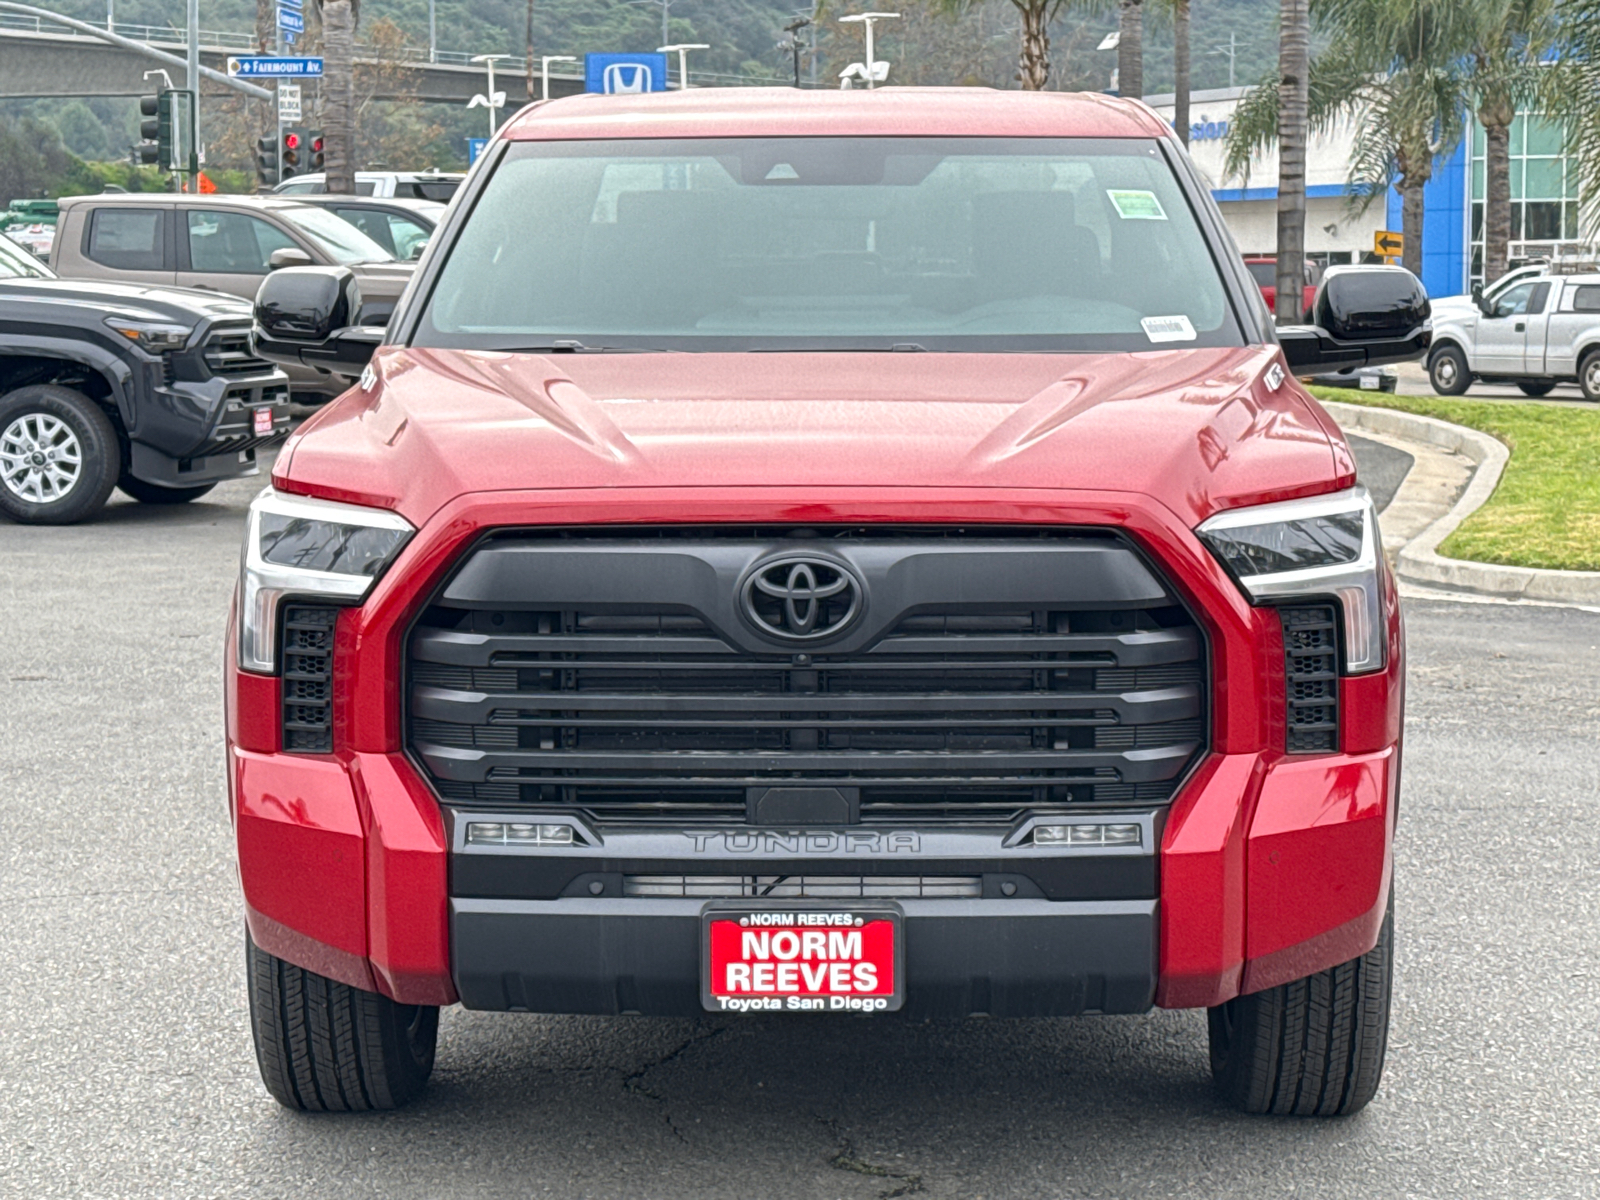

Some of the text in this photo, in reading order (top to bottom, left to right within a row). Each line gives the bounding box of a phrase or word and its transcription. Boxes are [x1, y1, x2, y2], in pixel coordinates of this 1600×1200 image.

[682, 830, 922, 853] TUNDRA
[750, 913, 853, 926] NORM REEVES
[741, 930, 862, 961] NORM
[726, 962, 879, 992] REEVES
[717, 996, 887, 1012] Toyota San Diego
